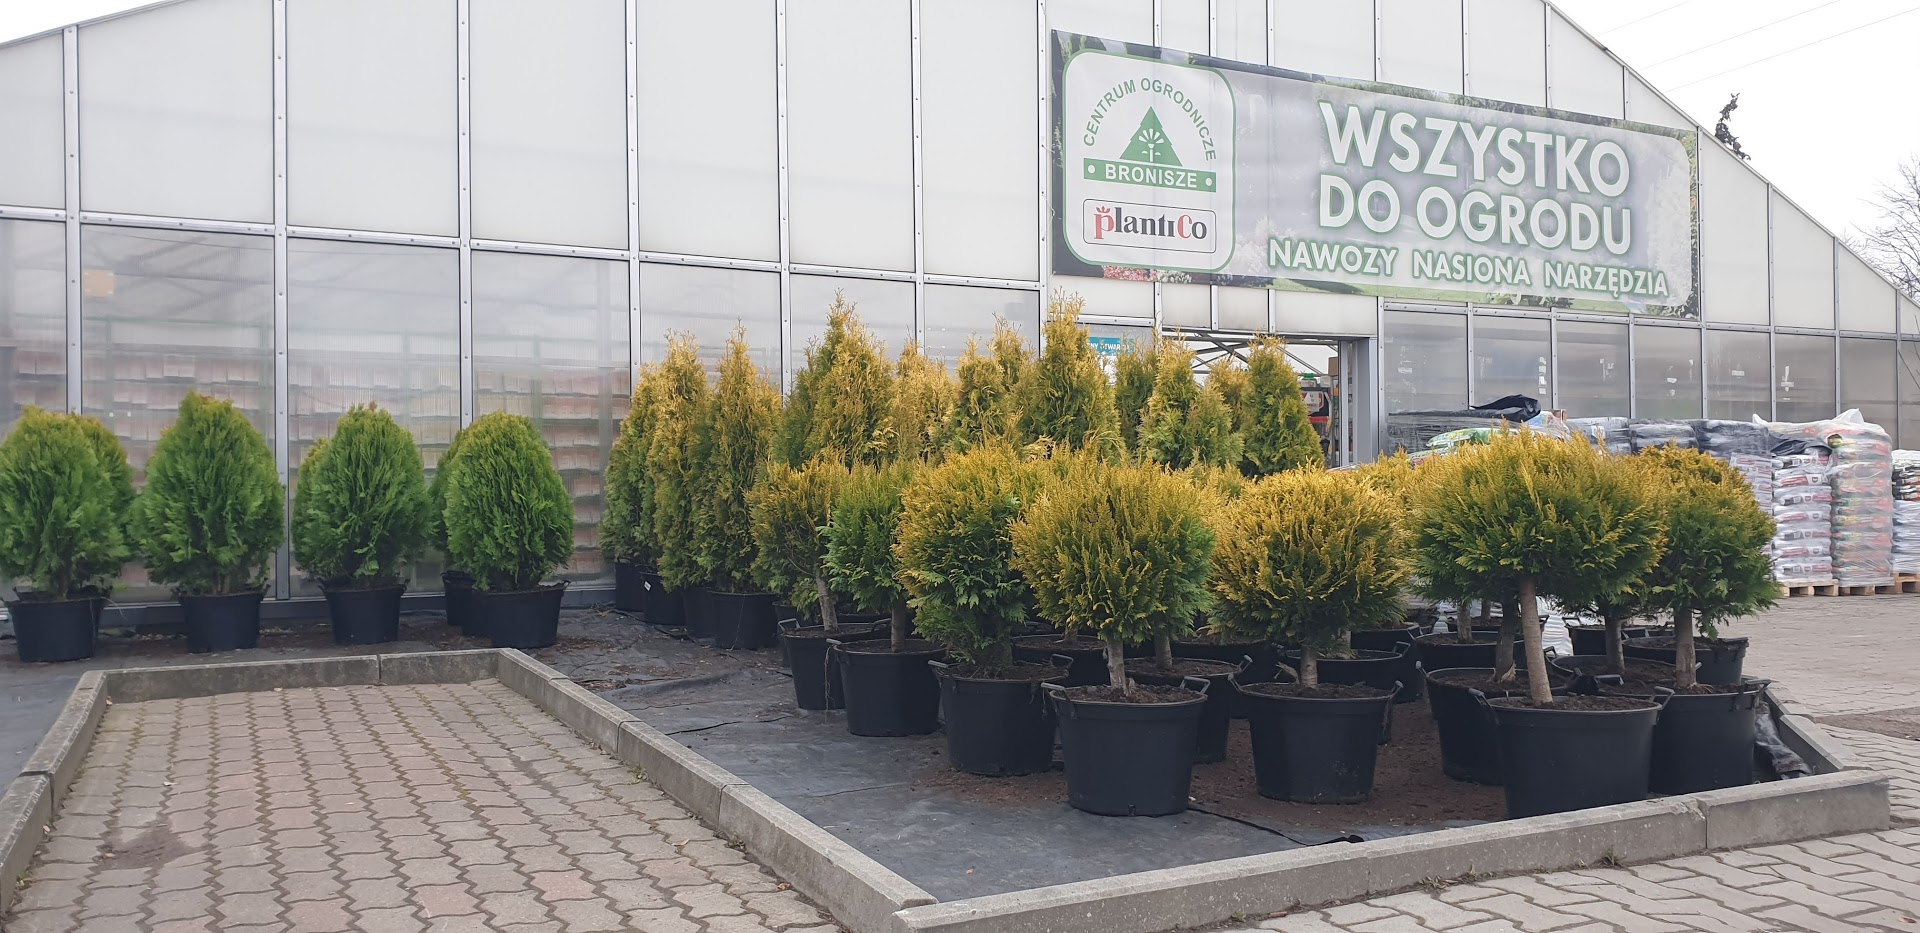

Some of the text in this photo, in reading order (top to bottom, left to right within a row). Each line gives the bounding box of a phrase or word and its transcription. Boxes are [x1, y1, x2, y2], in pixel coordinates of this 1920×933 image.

[1083, 77, 1217, 162] CENTRUM OGRODNICZE
[1318, 101, 1631, 198] WSZYSTKO
[1104, 162, 1198, 188] BRONISZE
[1319, 173, 1631, 255] DO OGRODU
[1269, 238, 1669, 298] NAWOZY NASIONA NARZĘDZIA
